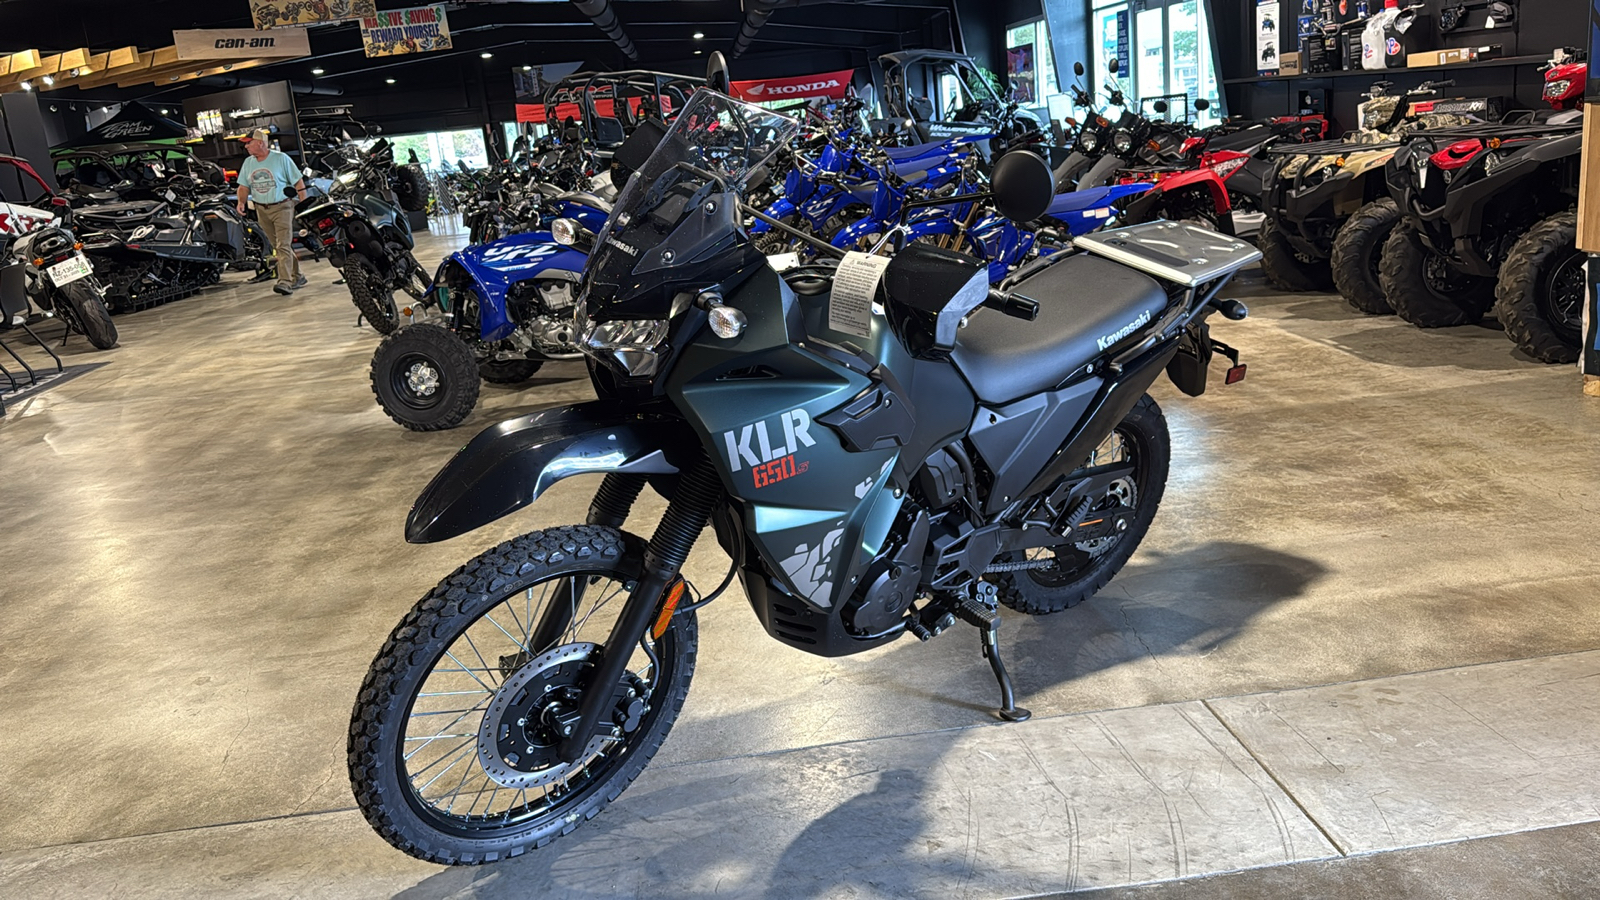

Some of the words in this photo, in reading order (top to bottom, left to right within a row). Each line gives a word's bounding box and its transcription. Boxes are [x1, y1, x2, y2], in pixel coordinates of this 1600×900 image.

[370, 27, 403, 44] REWARD
[403, 23, 440, 41] YOURSELF
[214, 37, 275, 49] can-am
[766, 79, 840, 95] HONDA
[99, 120, 142, 134] TEAM
[104, 125, 153, 139] GREEN
[856, 260, 877, 269] WARNING
[1096, 309, 1151, 352] Kawasaki
[723, 408, 817, 473] KLR
[752, 454, 797, 489] 650
